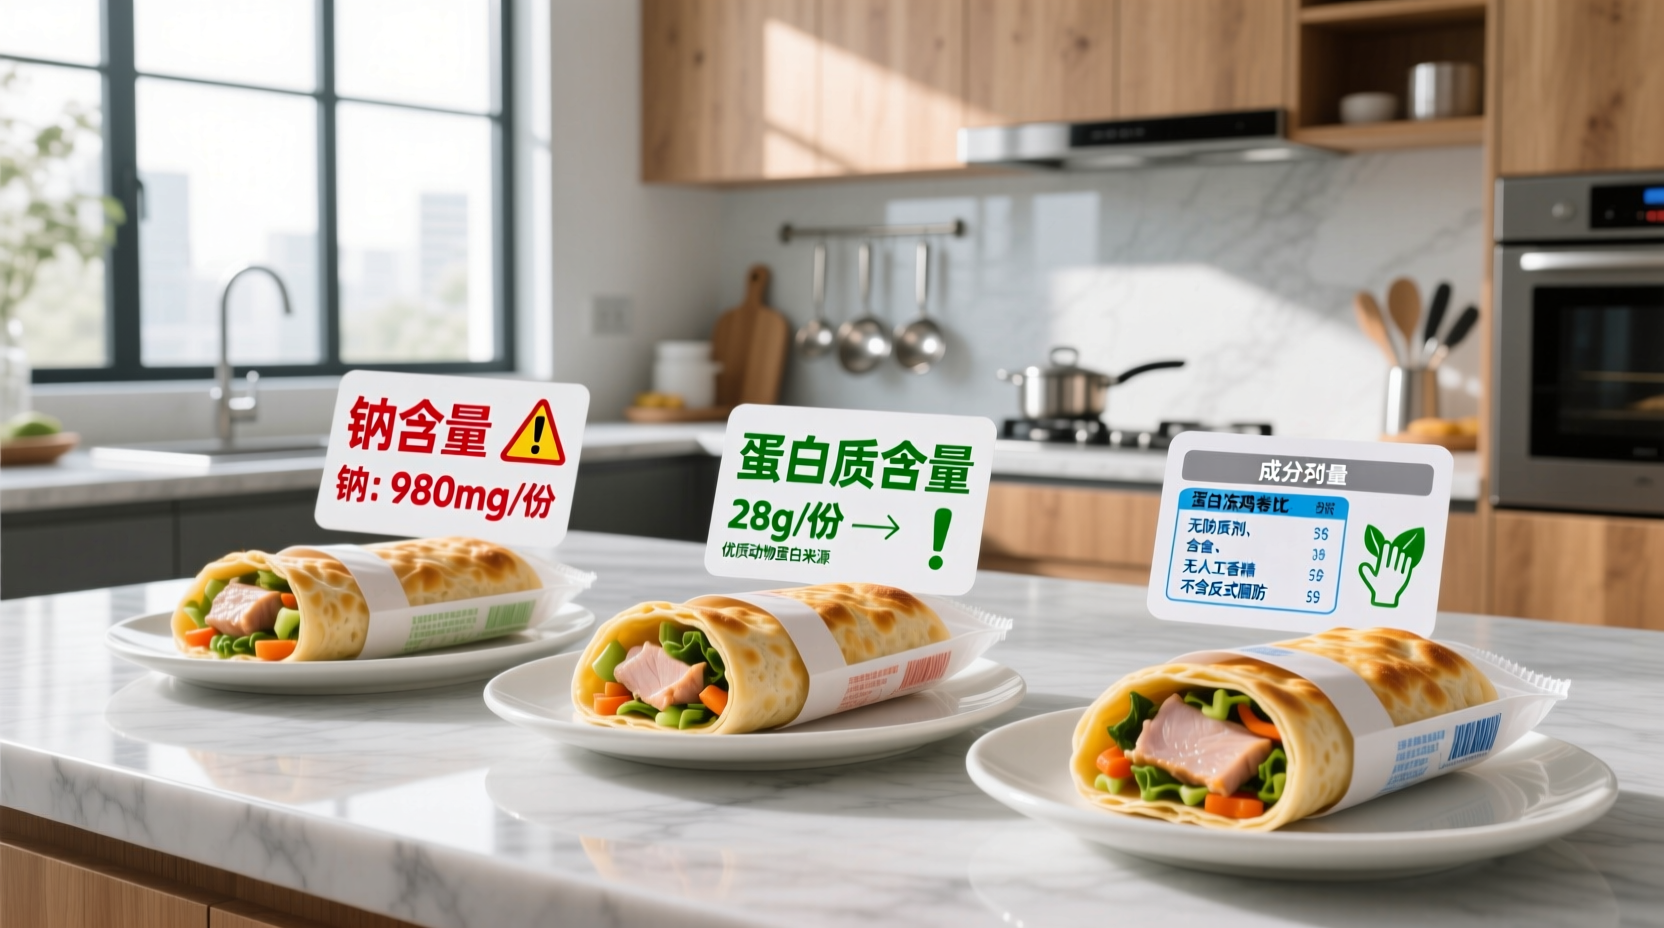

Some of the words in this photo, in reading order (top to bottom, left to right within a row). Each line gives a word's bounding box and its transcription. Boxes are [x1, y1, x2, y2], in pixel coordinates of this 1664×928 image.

[348, 396, 492, 457] 钠含量
[737, 432, 974, 494] 蛋白质含量
[391, 471, 555, 521] 980mg/份
[728, 498, 844, 542] 28g/份
